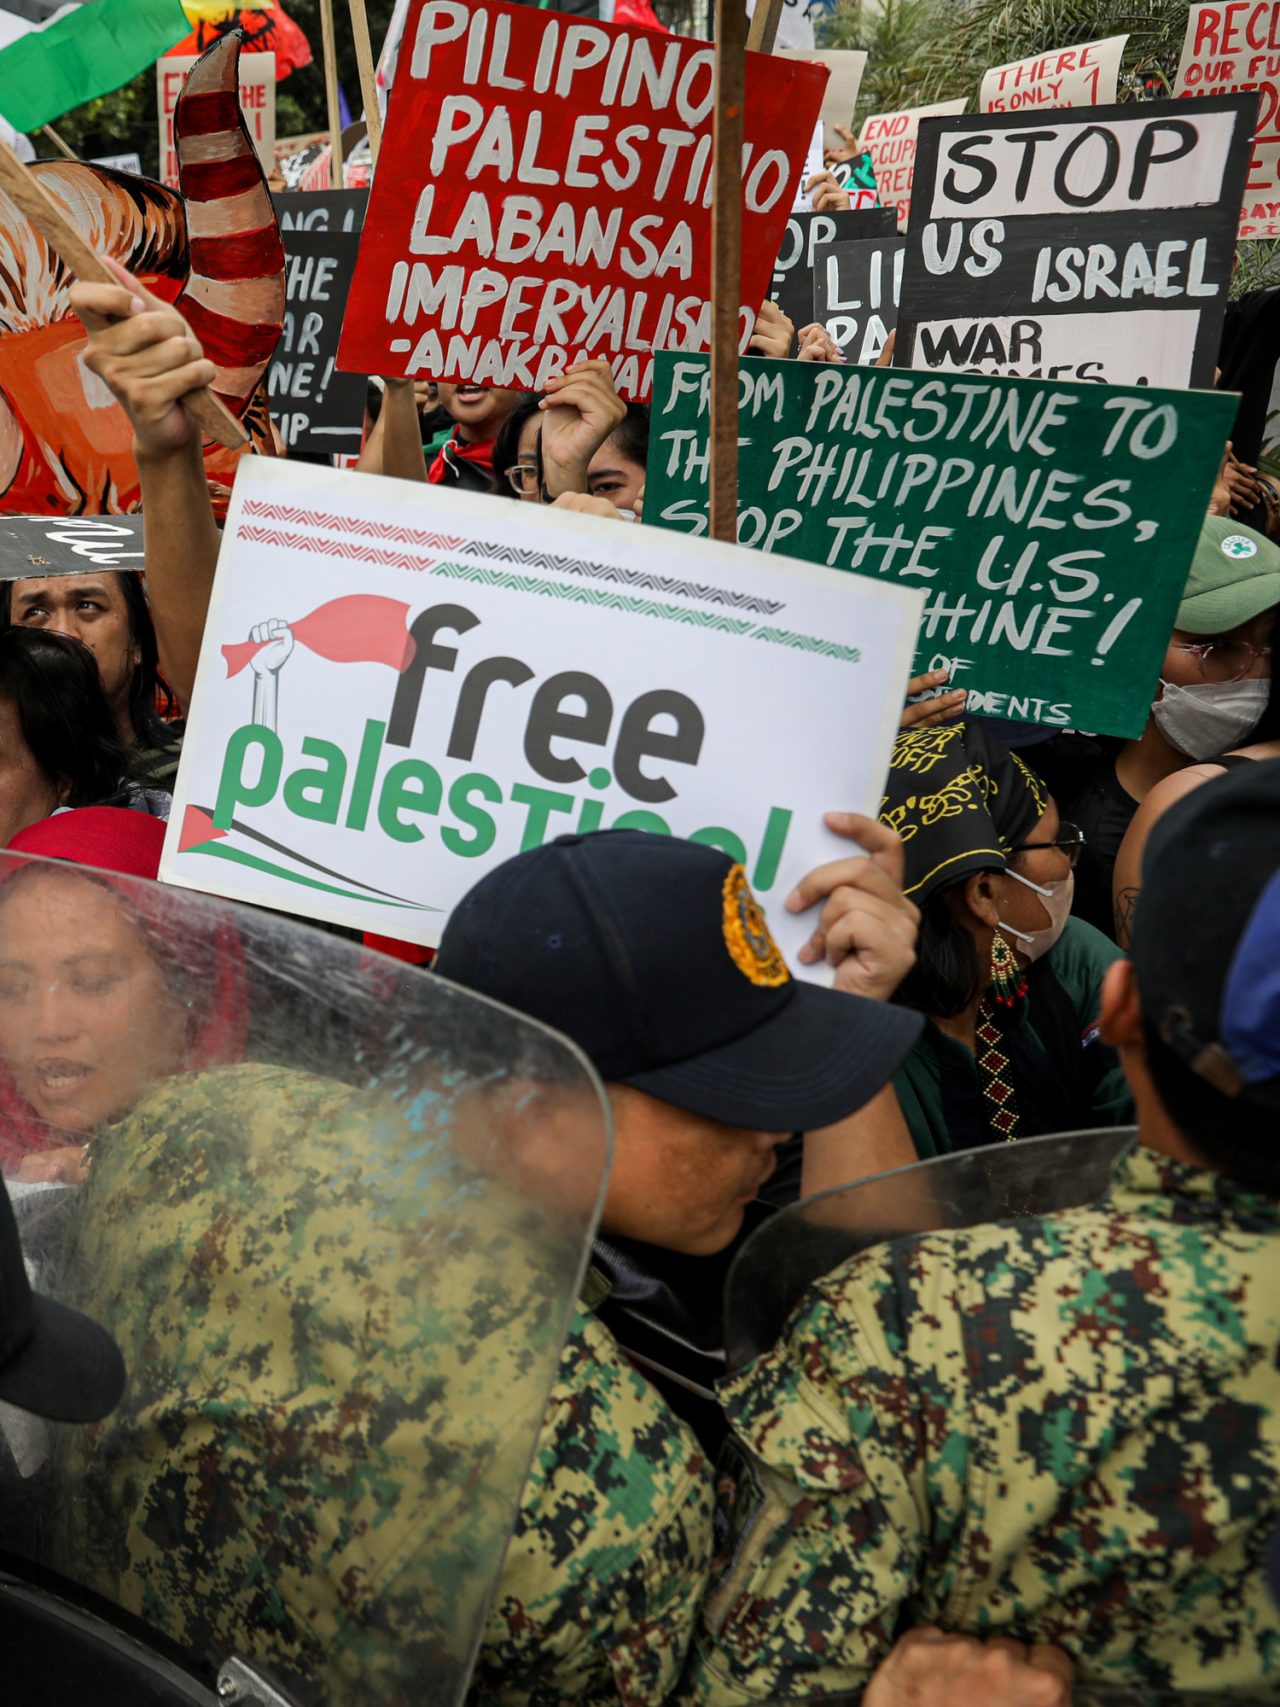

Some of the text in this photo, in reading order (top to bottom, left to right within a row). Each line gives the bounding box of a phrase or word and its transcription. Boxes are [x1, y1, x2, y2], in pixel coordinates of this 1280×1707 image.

[987, 98, 1006, 113] IS
[1009, 78, 1063, 108] ONLY
[989, 44, 1103, 91] THERE
[1184, 61, 1235, 86] OUR
[864, 116, 910, 141] END
[942, 119, 1199, 208] STOP
[922, 219, 1219, 303] US ISRAEL
[920, 320, 1043, 368] WAR
[806, 368, 1080, 456] PALESTINE
[1101, 396, 1178, 460] TO
[767, 436, 1160, 543] PHILIPPINES,
[826, 514, 955, 578] THE
[976, 535, 1114, 603] U.S.
[928, 653, 976, 685] OF
[385, 603, 705, 803] free
